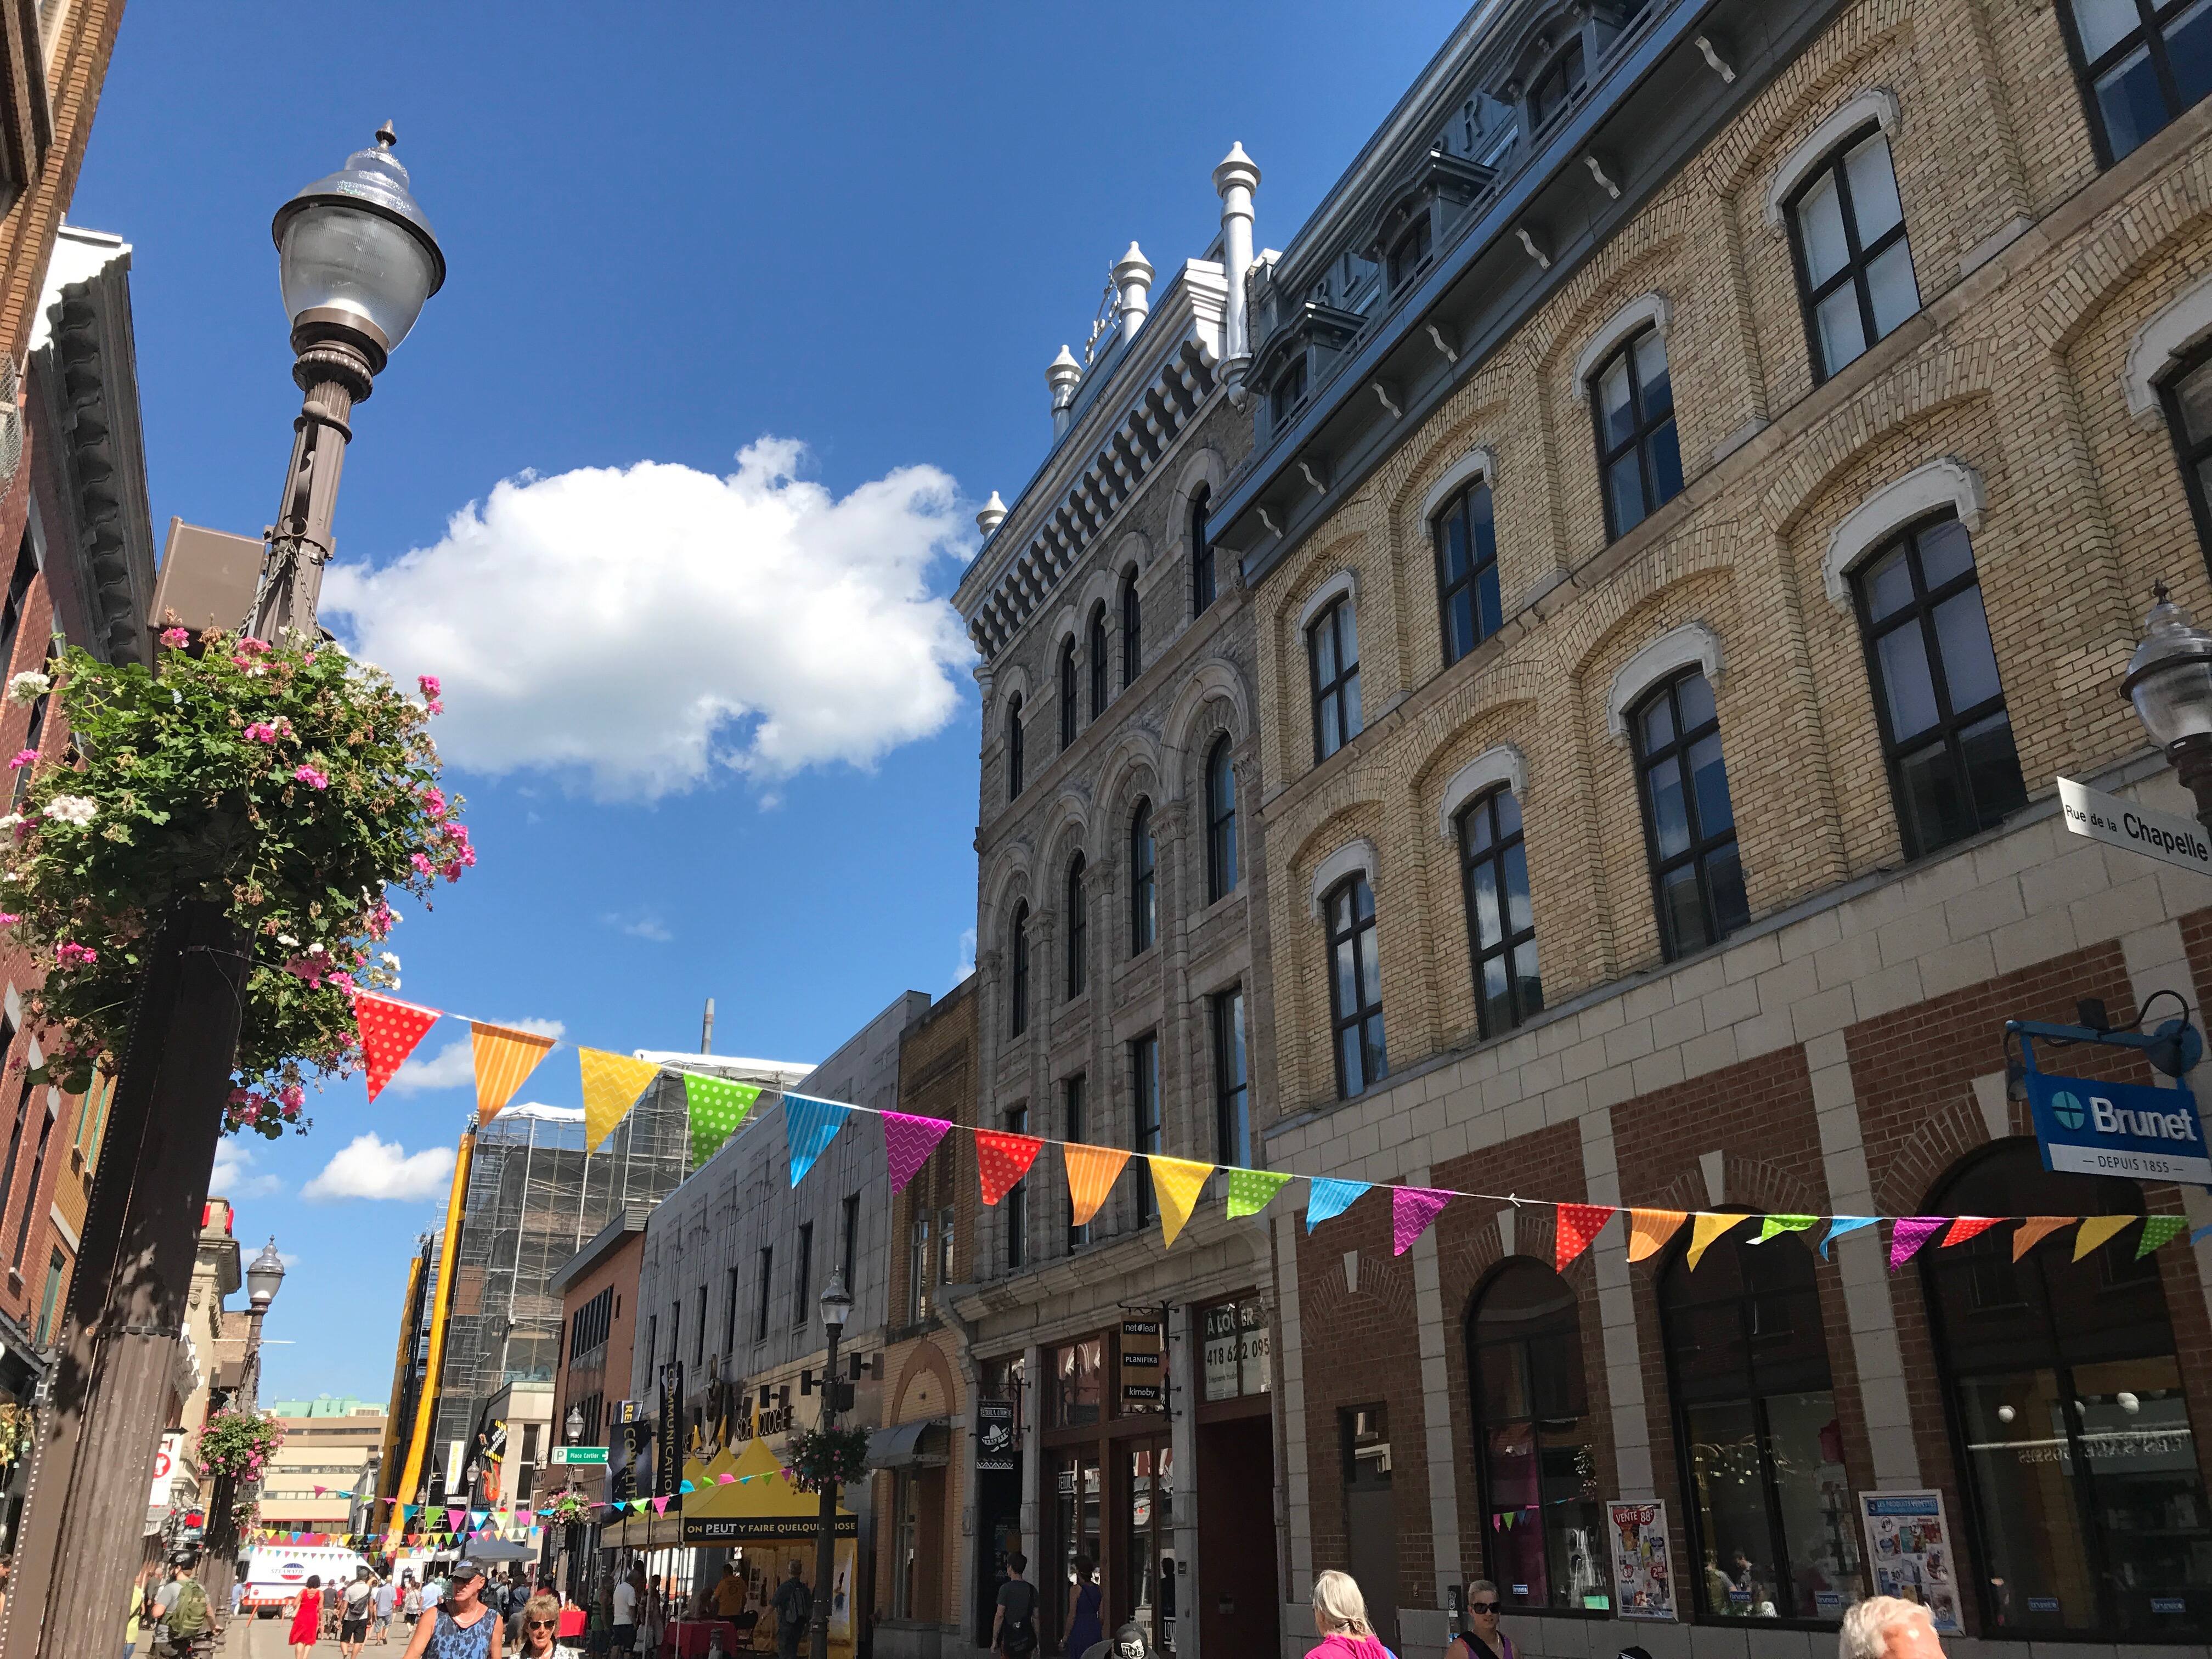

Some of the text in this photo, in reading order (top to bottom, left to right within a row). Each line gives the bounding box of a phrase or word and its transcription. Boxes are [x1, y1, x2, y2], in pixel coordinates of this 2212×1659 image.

[2065, 804, 2209, 861] Rue de la Chapelle
[2089, 1097, 2197, 1141] Brunet
[2098, 1155, 2169, 1173] DEPUIS 1855
[1207, 1347, 1224, 1367] 418
[1129, 1387, 1155, 1398] kimoby
[664, 1368, 675, 1495] COMMUNICATIO
[1615, 1511, 1638, 1523] VENTE
[687, 1525, 702, 1533] ON
[706, 1523, 737, 1534] PEUT
[748, 1523, 775, 1532] FAIRE
[777, 1522, 820, 1533] QUELQU
